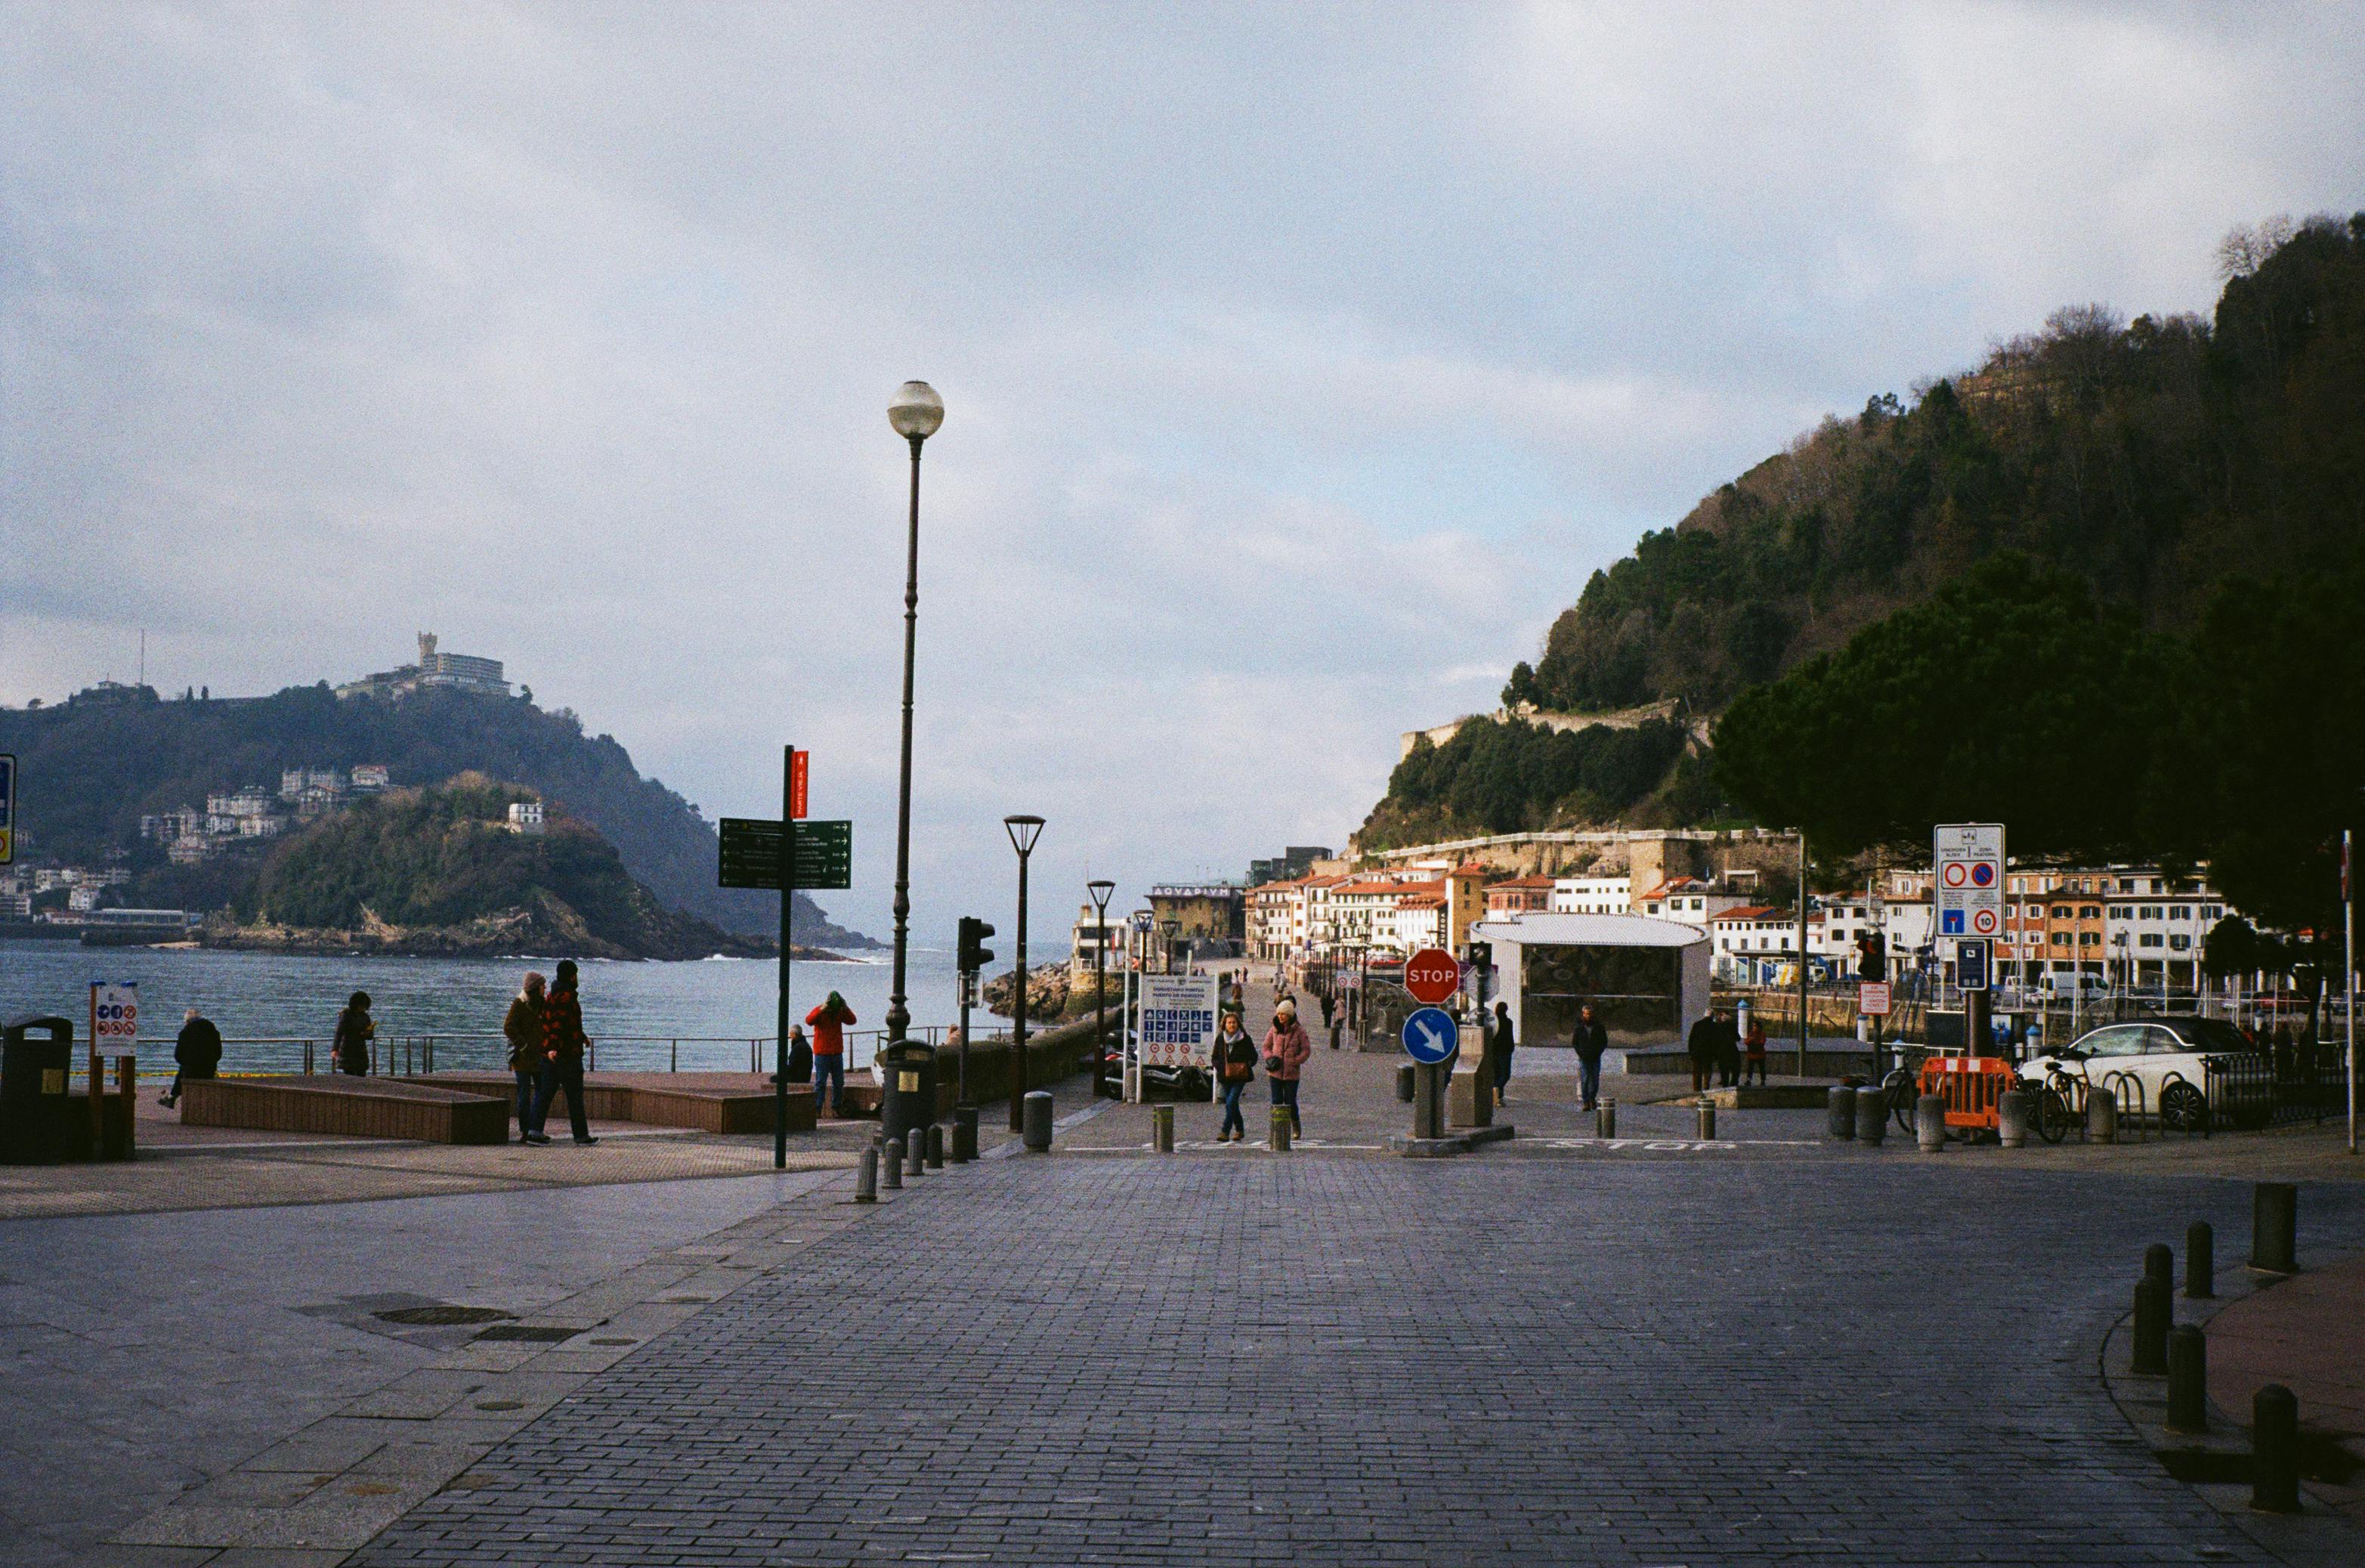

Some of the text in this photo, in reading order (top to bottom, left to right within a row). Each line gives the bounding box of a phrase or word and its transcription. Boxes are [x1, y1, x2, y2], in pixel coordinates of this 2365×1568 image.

[1980, 917, 1992, 926] 10
[1409, 970, 1455, 982] STOP
[1545, 1140, 1738, 1151] STOP
